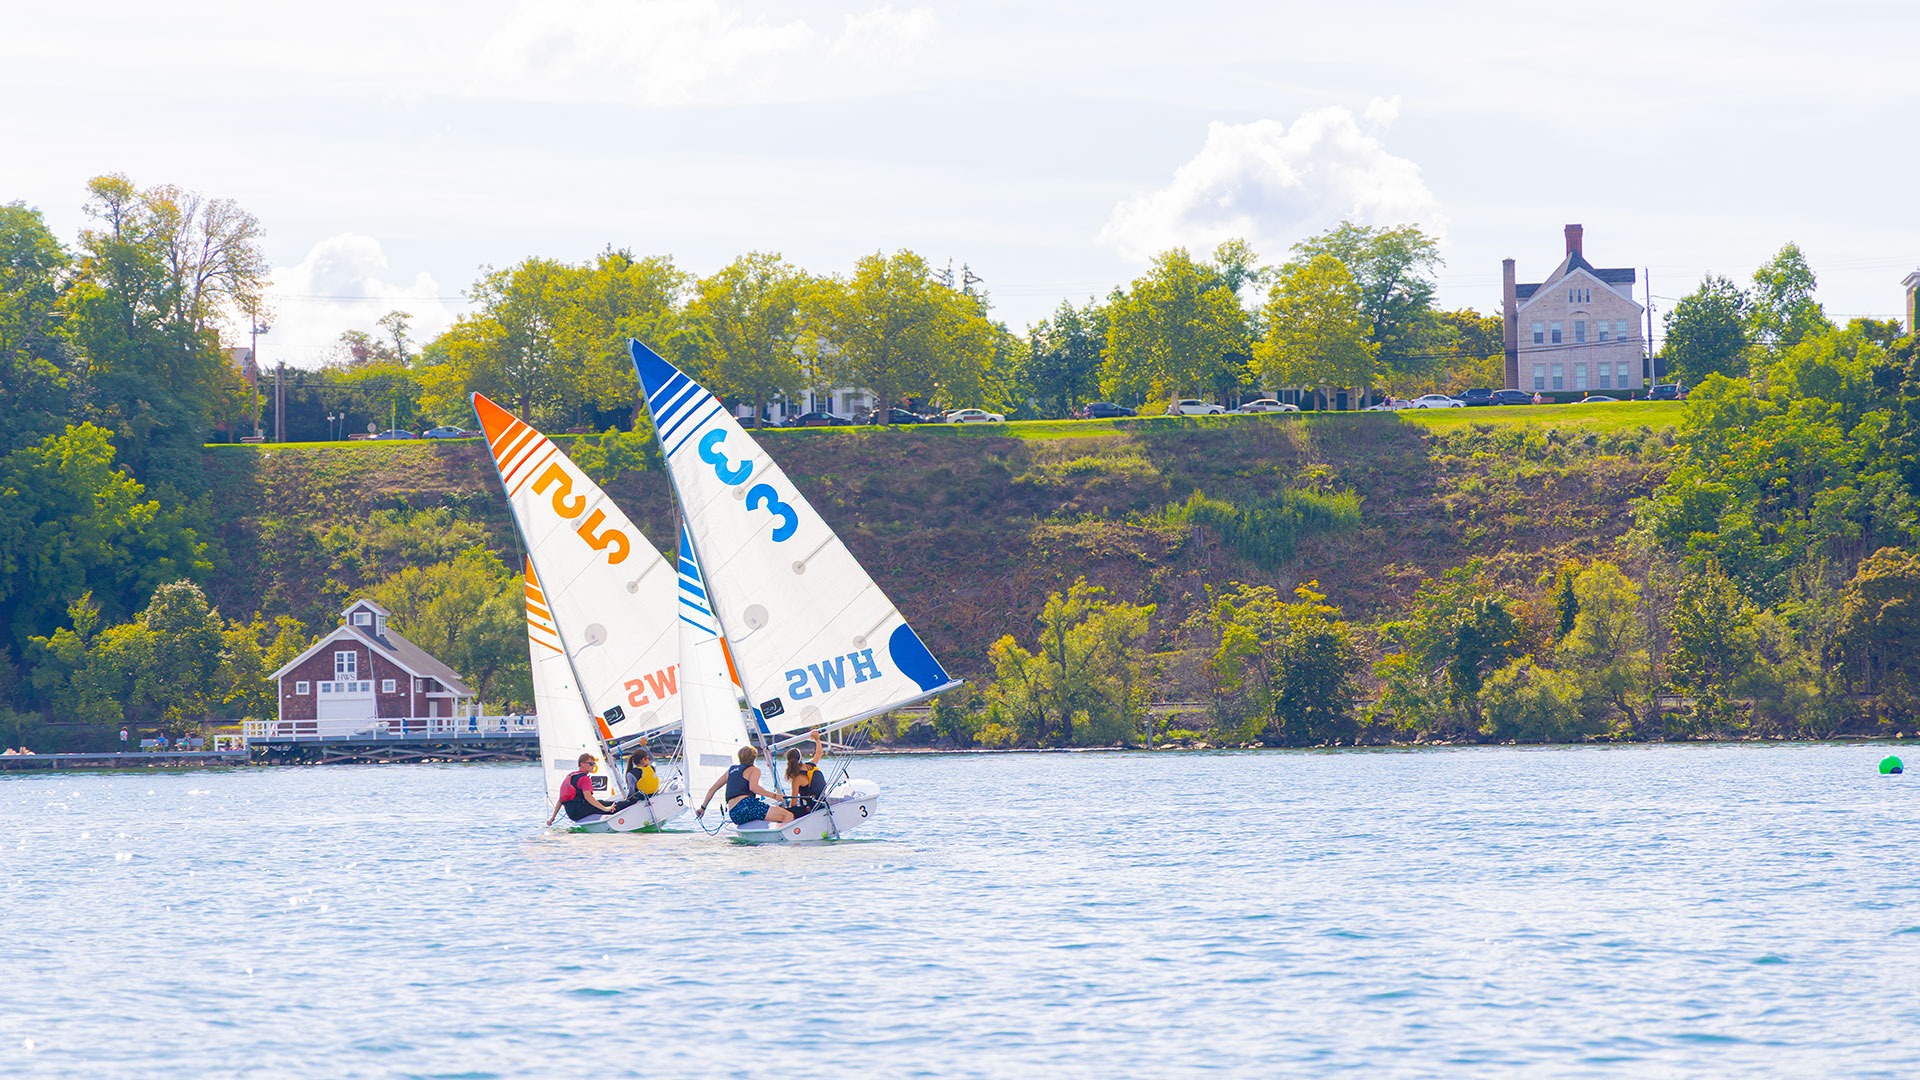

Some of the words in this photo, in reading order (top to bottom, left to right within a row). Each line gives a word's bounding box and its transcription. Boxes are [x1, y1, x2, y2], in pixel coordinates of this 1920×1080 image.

[745, 483, 799, 543] 3
[577, 508, 630, 565] 5
[336, 673, 356, 681] HWS
[675, 795, 684, 807] 5
[859, 805, 868, 818] 3
